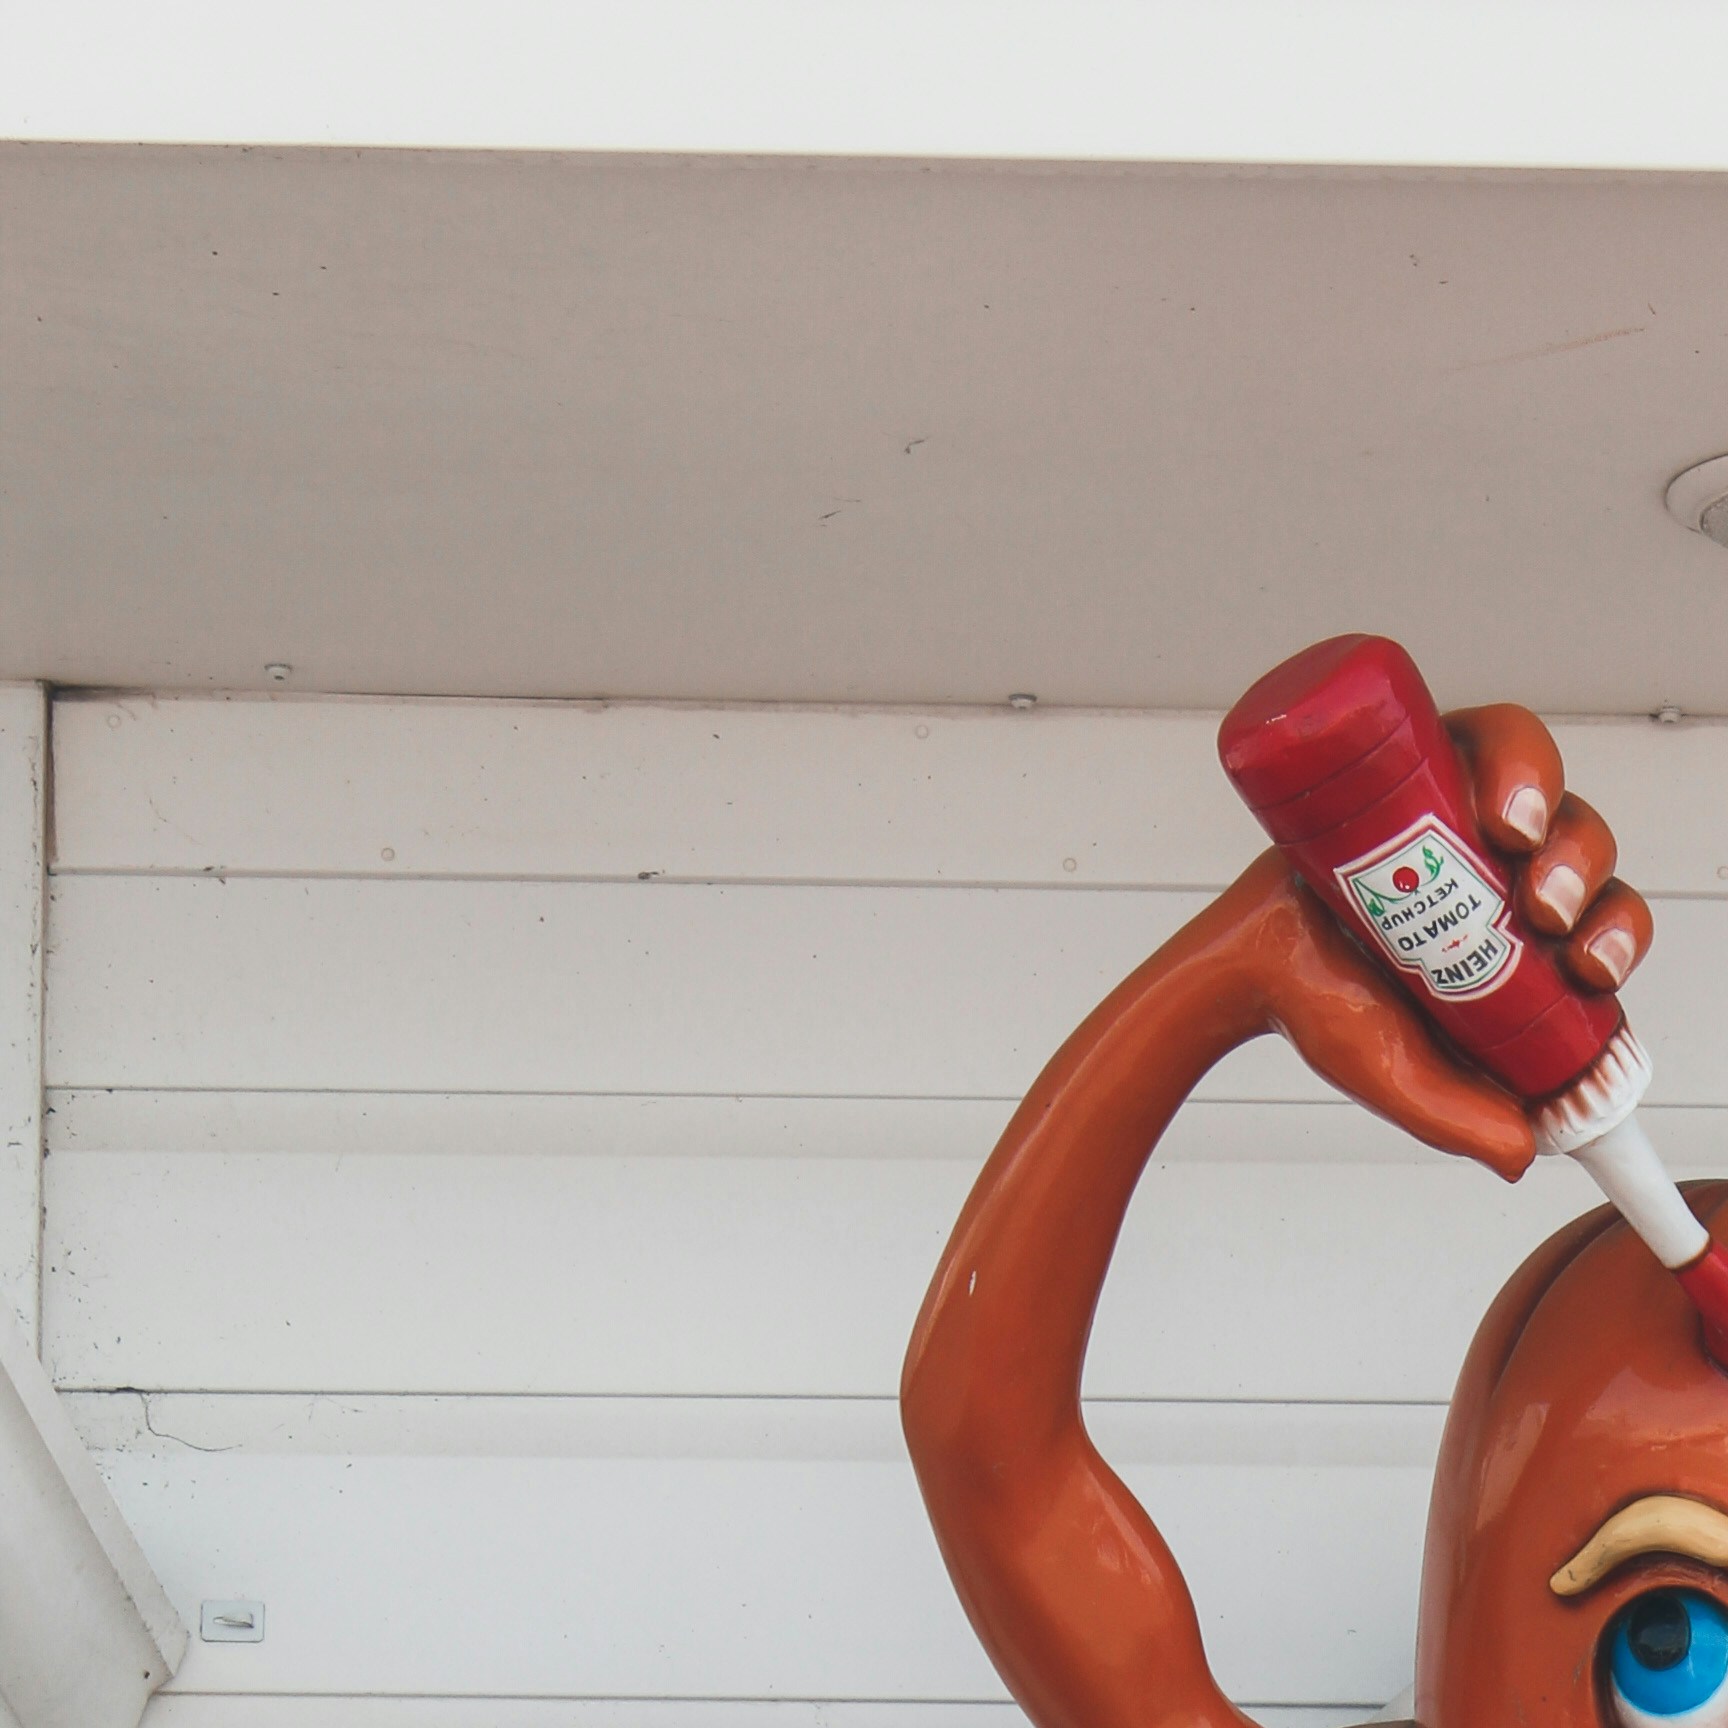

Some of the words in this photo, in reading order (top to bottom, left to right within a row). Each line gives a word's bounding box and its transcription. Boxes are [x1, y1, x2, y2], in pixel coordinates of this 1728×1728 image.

[1381, 877, 1459, 932] KETCHUP
[1397, 893, 1482, 952] TOMATO
[1431, 938, 1499, 985] HEINZ
